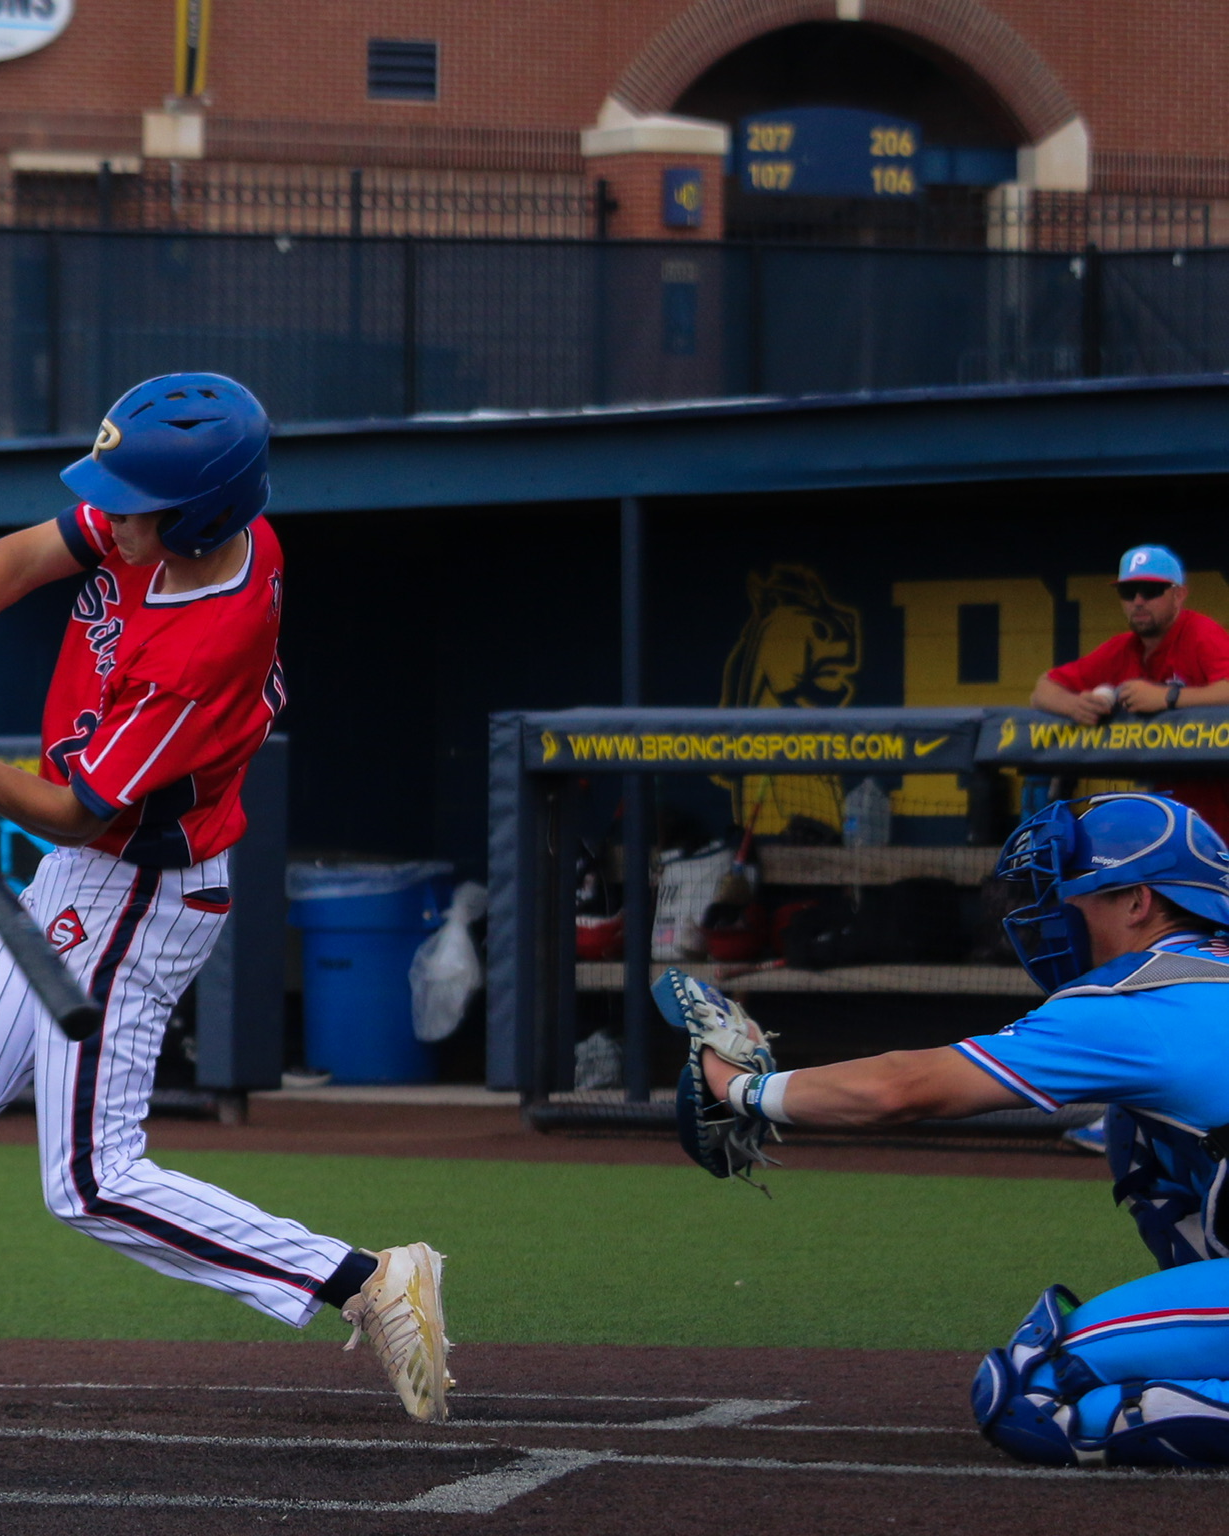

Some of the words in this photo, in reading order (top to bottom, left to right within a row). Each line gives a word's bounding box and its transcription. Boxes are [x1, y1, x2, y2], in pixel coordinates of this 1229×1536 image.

[747, 122, 794, 152] 207
[870, 126, 915, 158] 206
[748, 160, 793, 191] 107
[872, 166, 915, 195] 106
[92, 418, 122, 462] P
[1129, 551, 1148, 573] P
[568, 733, 905, 761] WWW.BRONCHOSPORTS.COM
[51, 917, 76, 952] S
